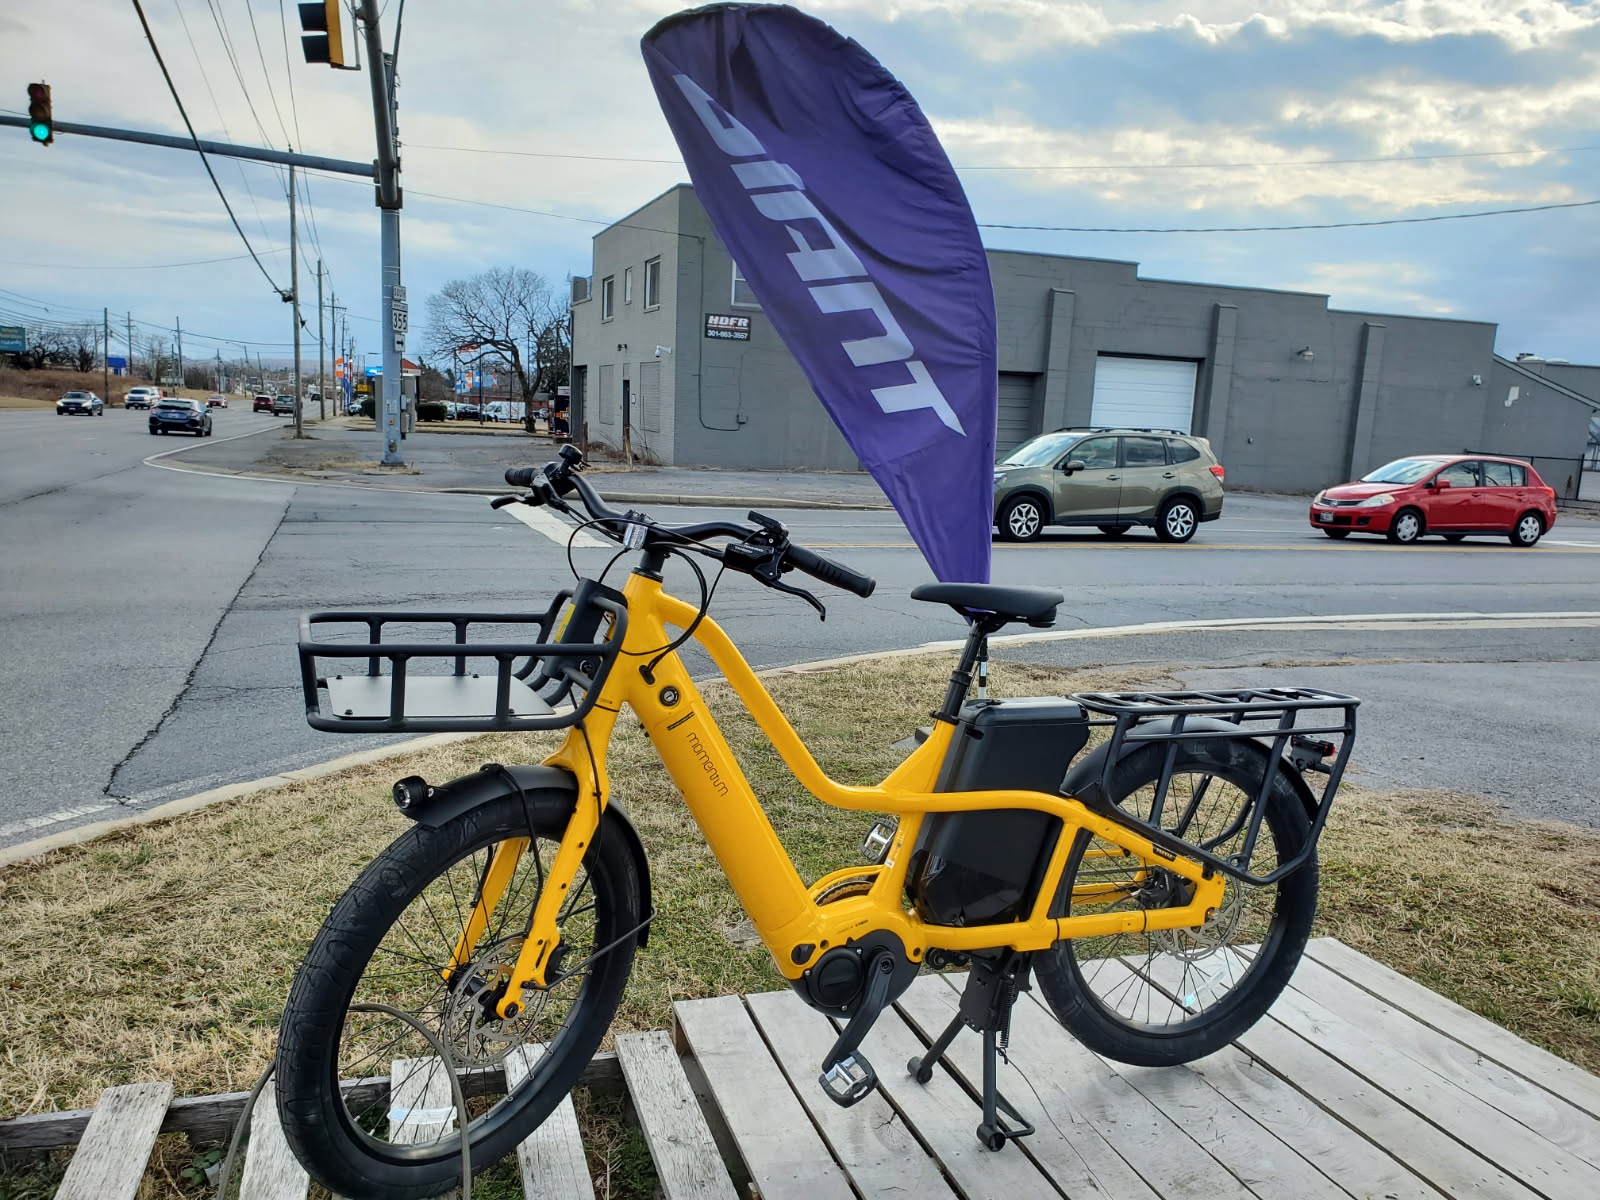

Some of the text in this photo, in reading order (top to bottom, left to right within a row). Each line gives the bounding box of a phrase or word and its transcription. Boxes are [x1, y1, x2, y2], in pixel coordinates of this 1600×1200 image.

[672, 74, 967, 437] GIANT
[393, 313, 408, 330] 355
[708, 315, 749, 327] HDFR
[686, 732, 729, 797] momentum
